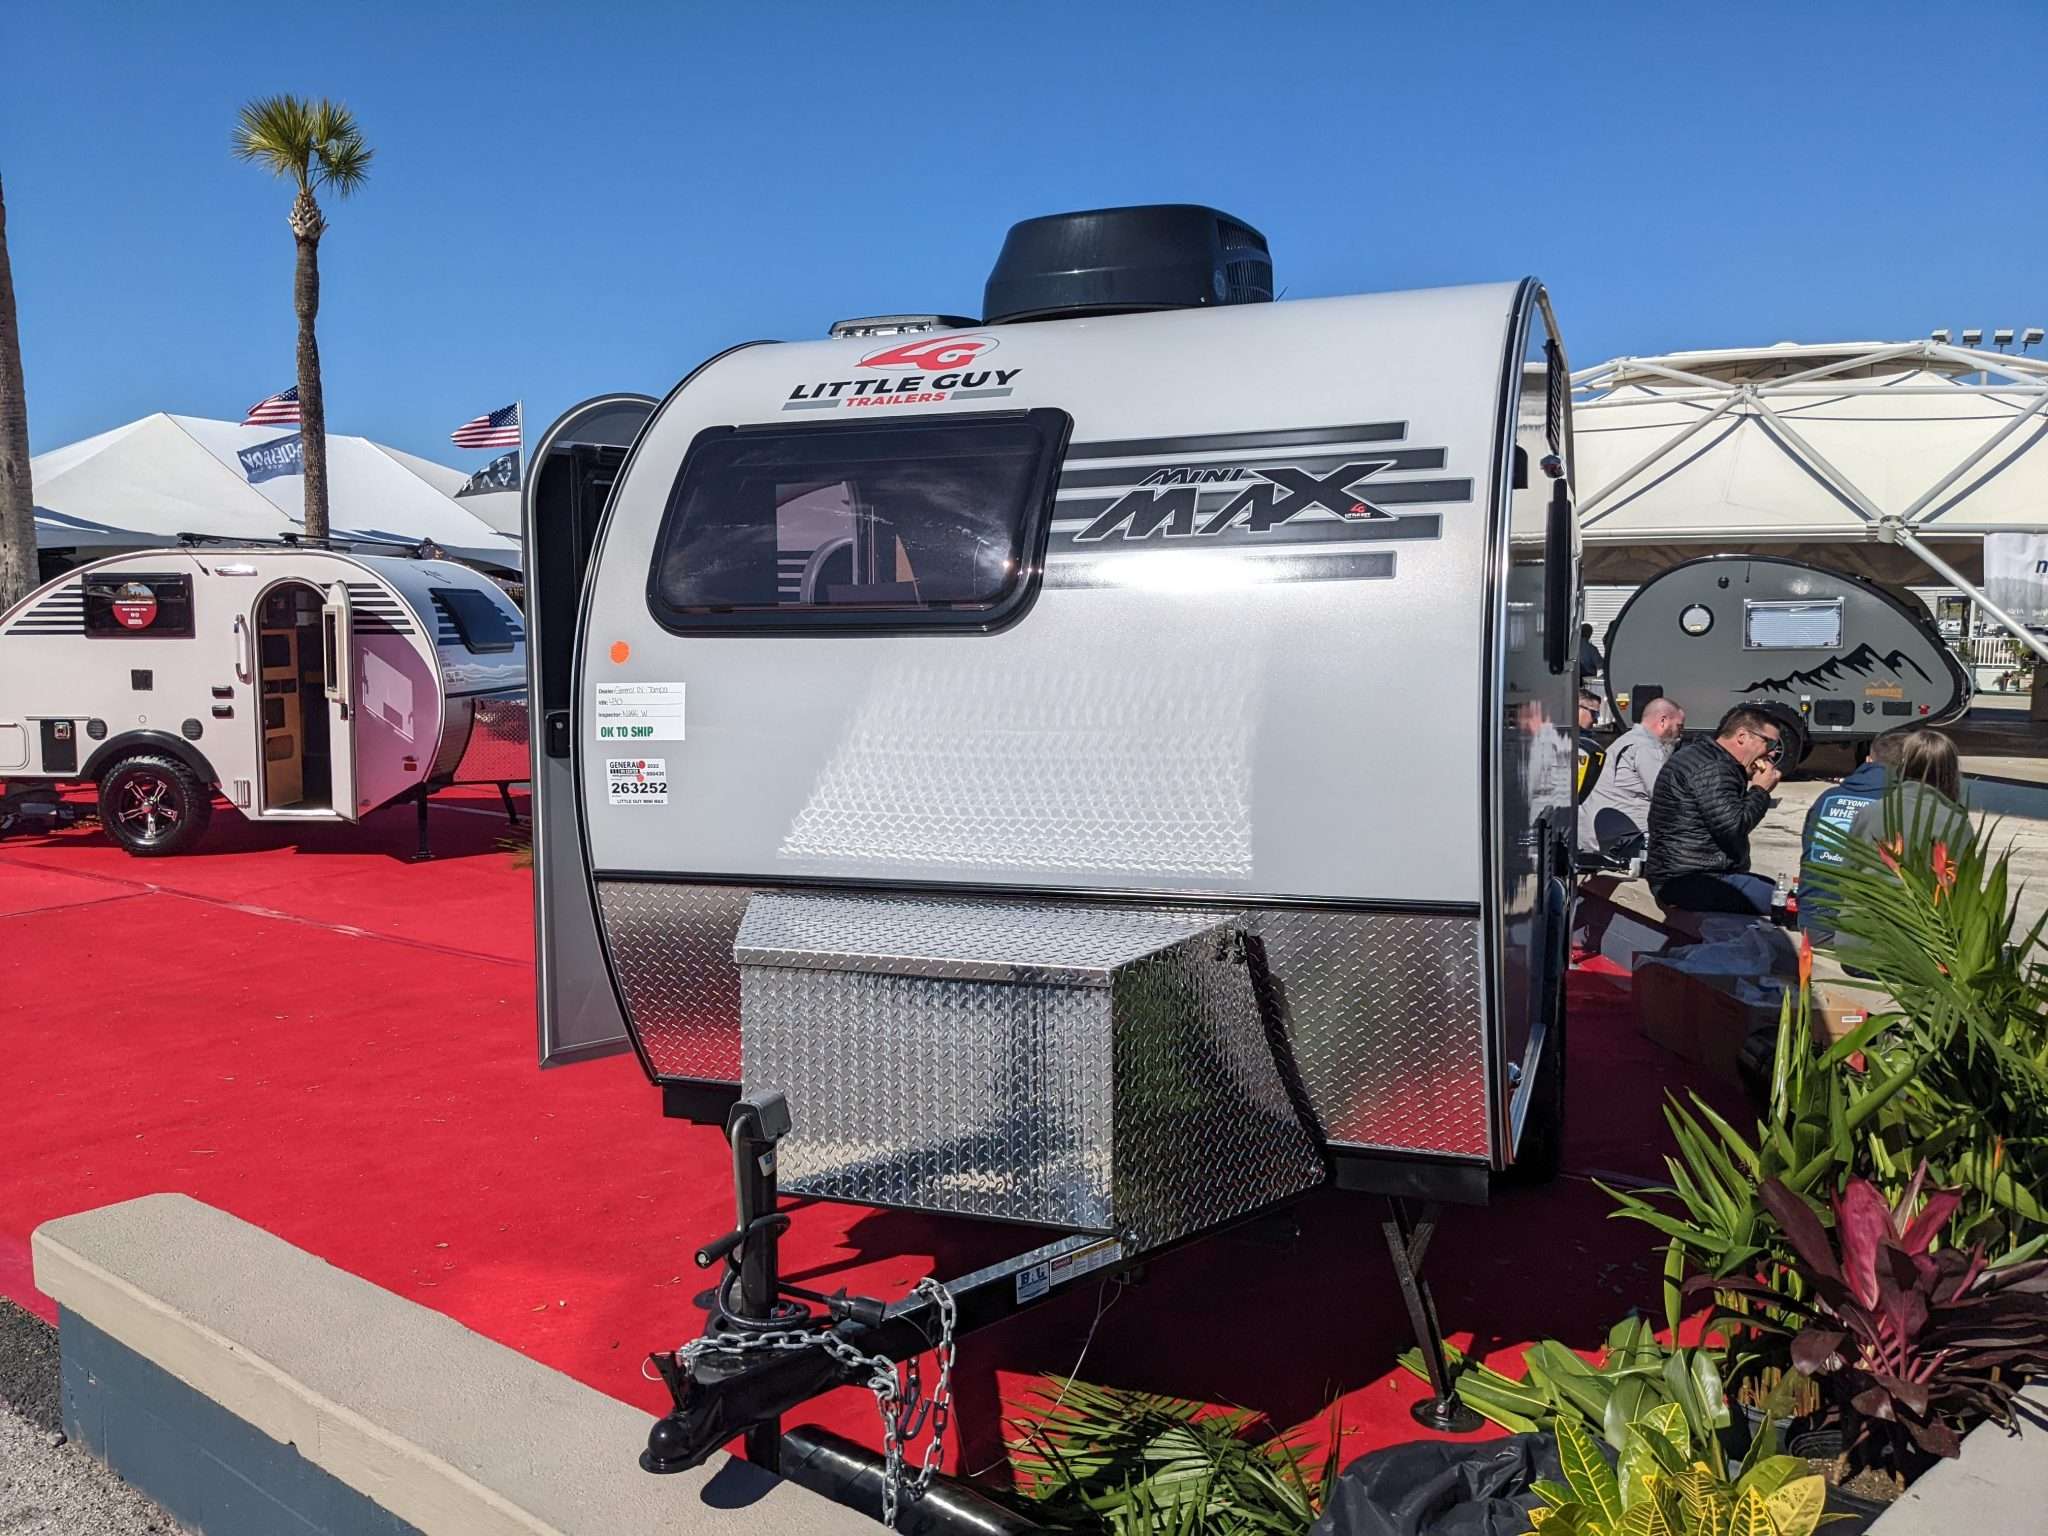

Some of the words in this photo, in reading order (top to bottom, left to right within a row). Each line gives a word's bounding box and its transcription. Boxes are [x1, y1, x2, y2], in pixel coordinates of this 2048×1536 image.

[789, 376, 925, 400] LITTLE
[931, 368, 1023, 390] GUY
[846, 392, 946, 408] TRAILERS
[1136, 467, 1247, 488] MINI
[1072, 460, 1398, 542] MAX
[600, 727, 614, 738] OK
[616, 727, 628, 738] TO
[631, 726, 654, 737] SHIP
[610, 761, 641, 769] GENERAL
[611, 782, 668, 794] 263252
